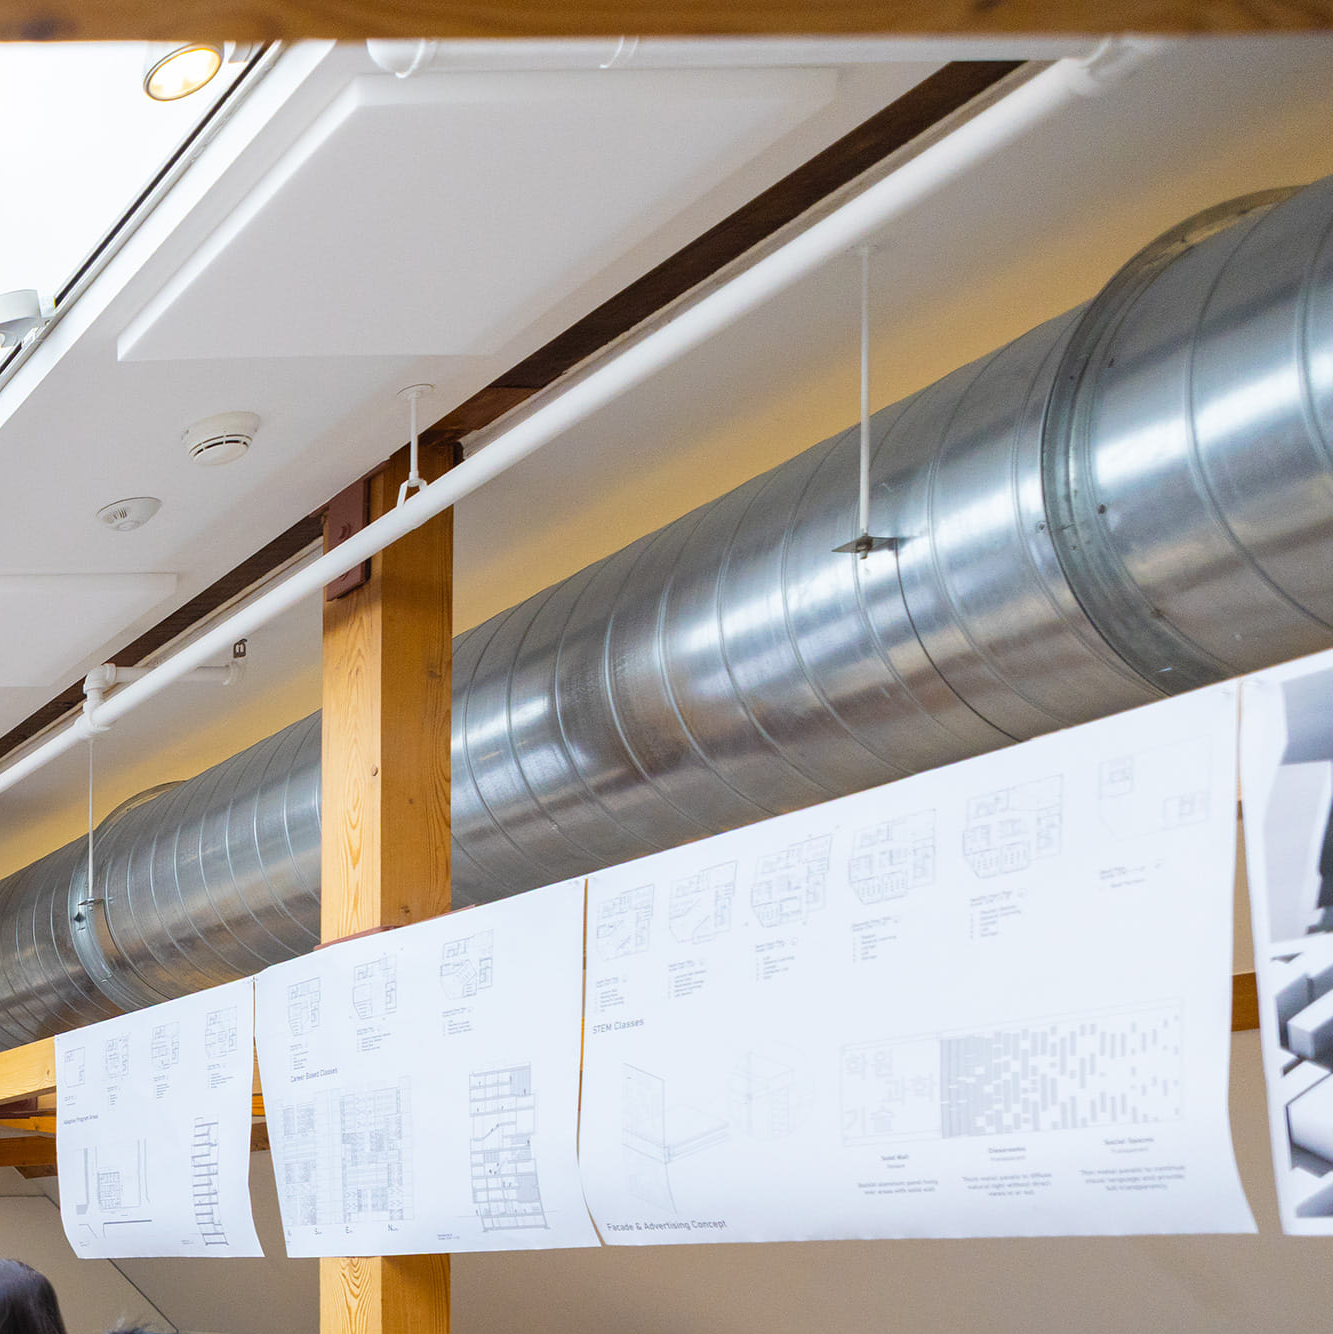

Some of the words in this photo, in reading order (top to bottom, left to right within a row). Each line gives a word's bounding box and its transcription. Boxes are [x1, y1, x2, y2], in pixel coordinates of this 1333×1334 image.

[592, 1023, 612, 1035] STEM
[613, 1018, 645, 1031] Classes
[320, 1068, 338, 1077] Classes
[606, 1222, 634, 1232] Facade
[635, 1222, 643, 1231] &
[643, 1220, 691, 1232] Advertising
[690, 1219, 727, 1231] Concept
